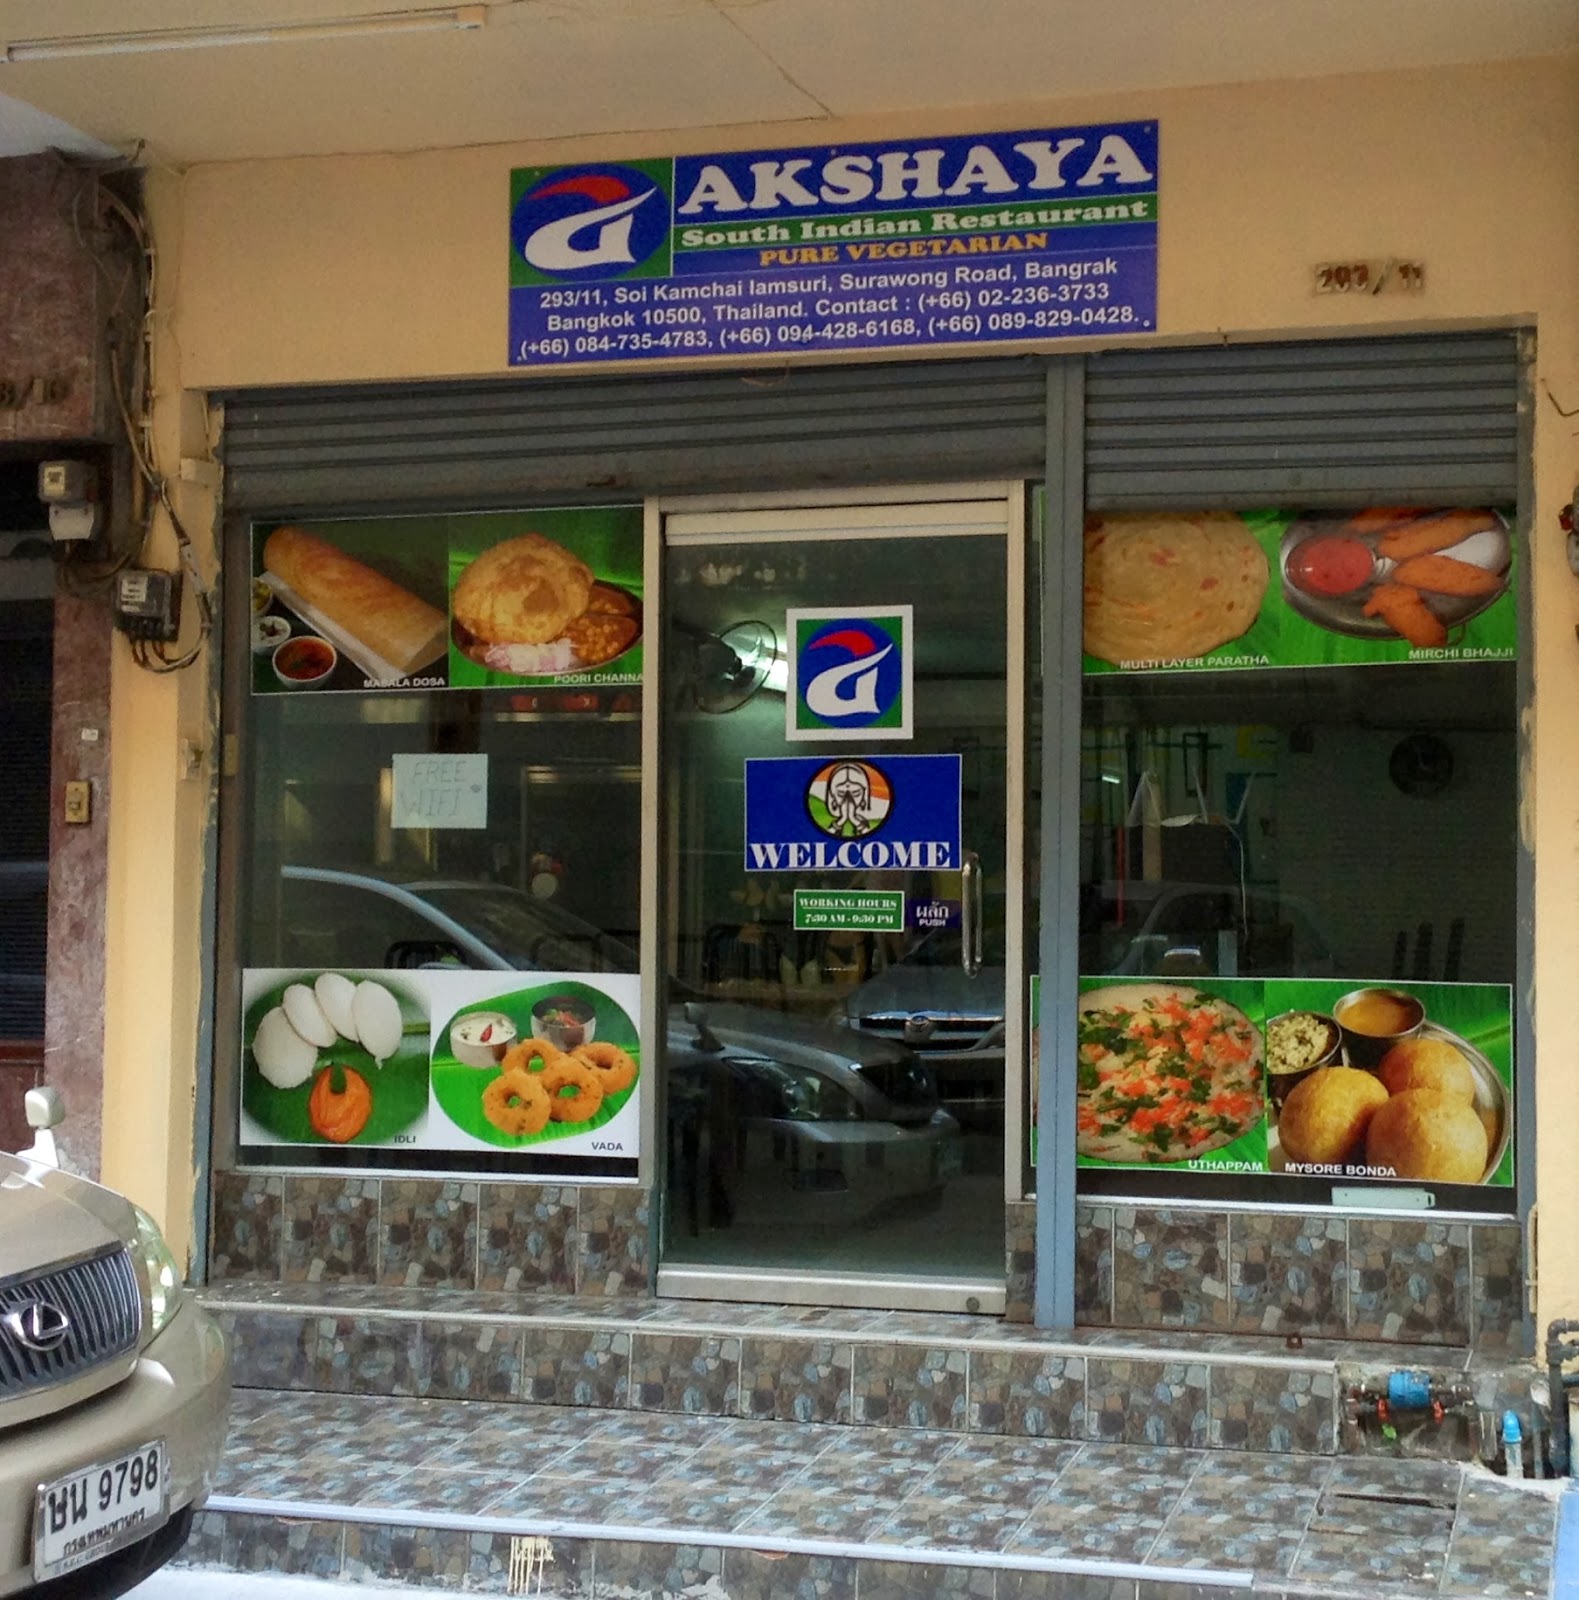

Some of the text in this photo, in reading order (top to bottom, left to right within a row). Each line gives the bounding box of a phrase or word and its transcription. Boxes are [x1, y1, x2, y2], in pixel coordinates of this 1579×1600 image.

[677, 133, 1154, 215] AKSHAYA
[681, 200, 1149, 248] South Indian Restaurant
[760, 232, 1048, 266] PURE VEGETARIAN
[540, 288, 608, 308] 293/11,
[614, 286, 648, 303] Soi
[654, 279, 743, 300] Kamchai
[840, 267, 948, 292] Surawong
[955, 262, 1018, 286] Road,
[1025, 257, 1118, 281] Bangrak
[547, 309, 635, 333] Bangkok
[642, 306, 706, 326] 10500,
[714, 301, 808, 321] Thailand.
[815, 297, 898, 316] Contact
[918, 292, 972, 313] (+66)
[978, 282, 1110, 306] 02-236-3733
[520, 305, 1139, 359] (+66) 084-735-4783, (+66) 094-428-6168, (+66) 089-829-0428.
[1408, 647, 1514, 660] MIRCHI BHAJJI
[1119, 655, 1270, 670] MULTI LAYER PARATHA
[363, 678, 446, 688] MASALA DOSA
[553, 674, 592, 684] POORI
[412, 760, 468, 784] FREE
[748, 841, 950, 868] WELCOME
[799, 898, 897, 909] WORKING HOURS
[830, 913, 846, 923] AM
[877, 915, 894, 924] PM
[919, 919, 946, 927] PUSH
[394, 1134, 416, 1144] IDLI
[591, 1141, 624, 1152] VADA
[1188, 1159, 1263, 1172] UTHAPPAM
[1285, 1162, 1397, 1178] MYSORE BONDA
[98, 1449, 159, 1512] 9798
